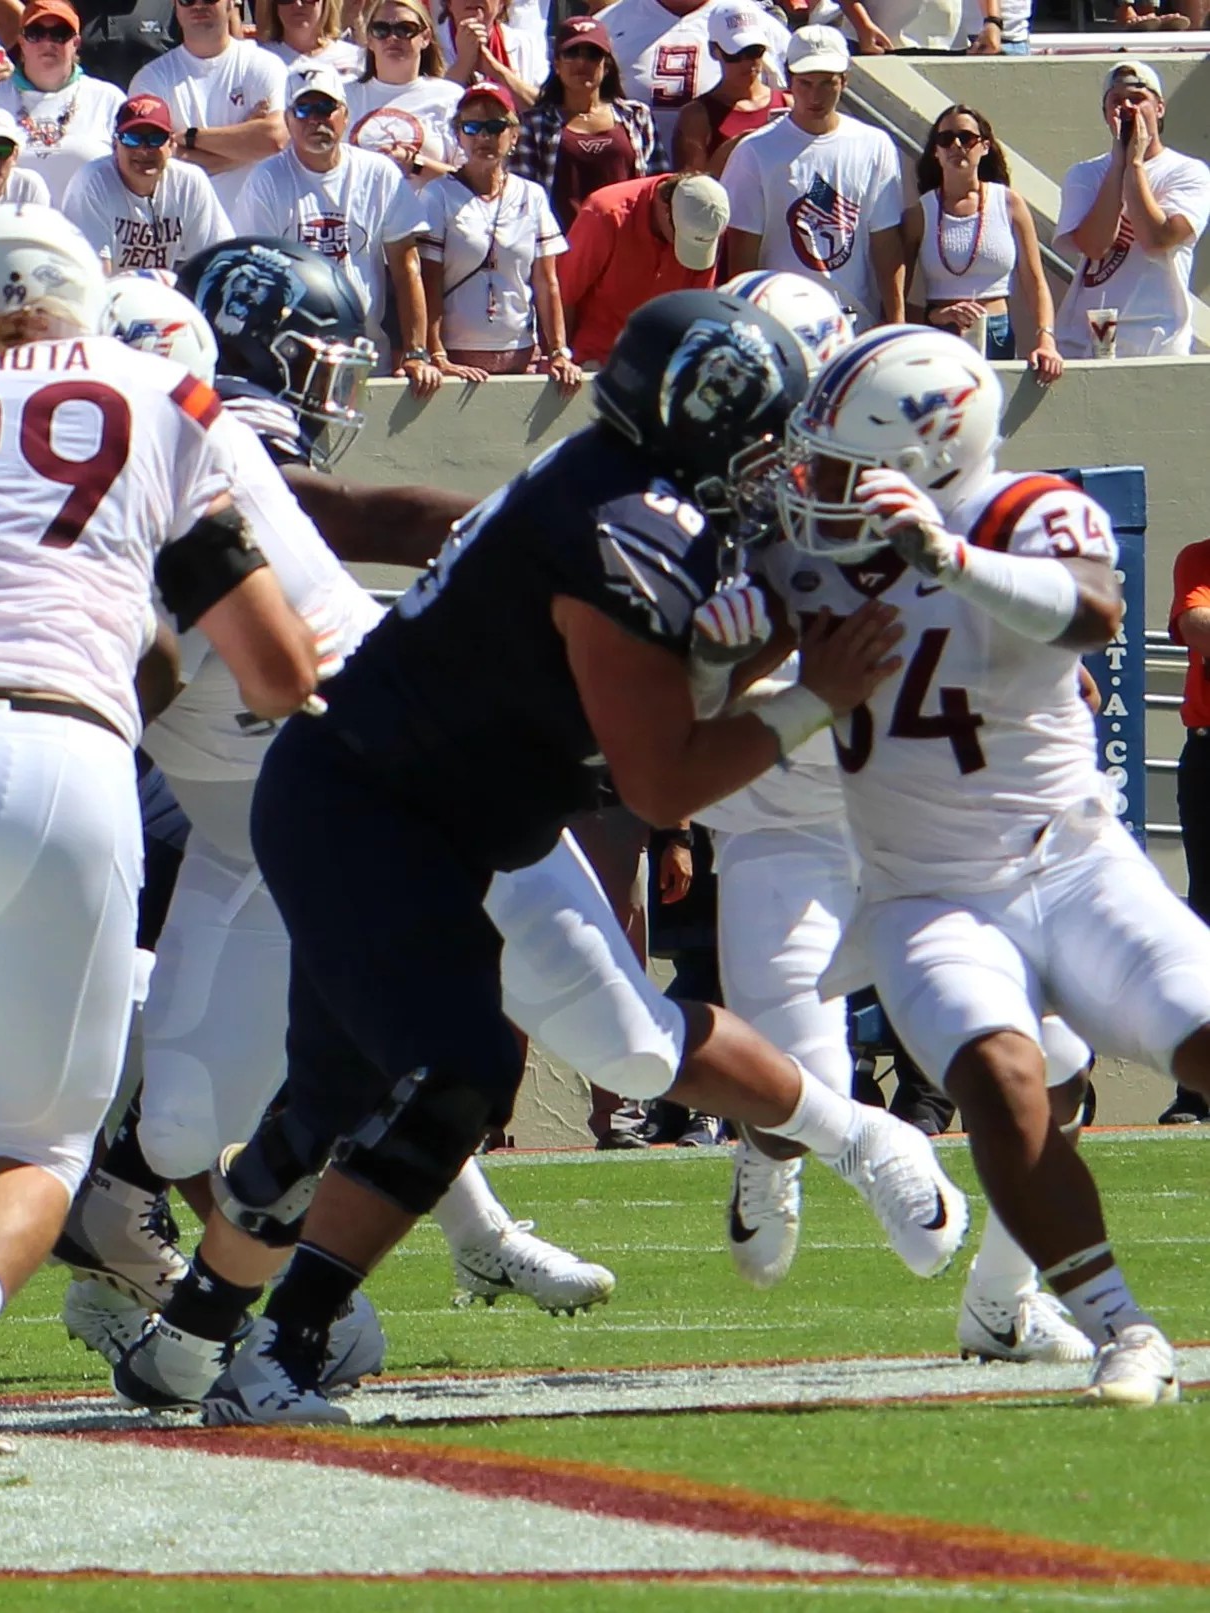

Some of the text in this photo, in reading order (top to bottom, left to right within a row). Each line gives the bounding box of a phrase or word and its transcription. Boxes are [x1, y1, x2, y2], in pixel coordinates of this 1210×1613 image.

[578, 138, 613, 153] VT
[115, 217, 182, 246] VIRGINIA
[119, 246, 167, 268] TECH
[3, 284, 26, 303] 99
[1042, 506, 1110, 557] 54
[859, 572, 886, 588] VT
